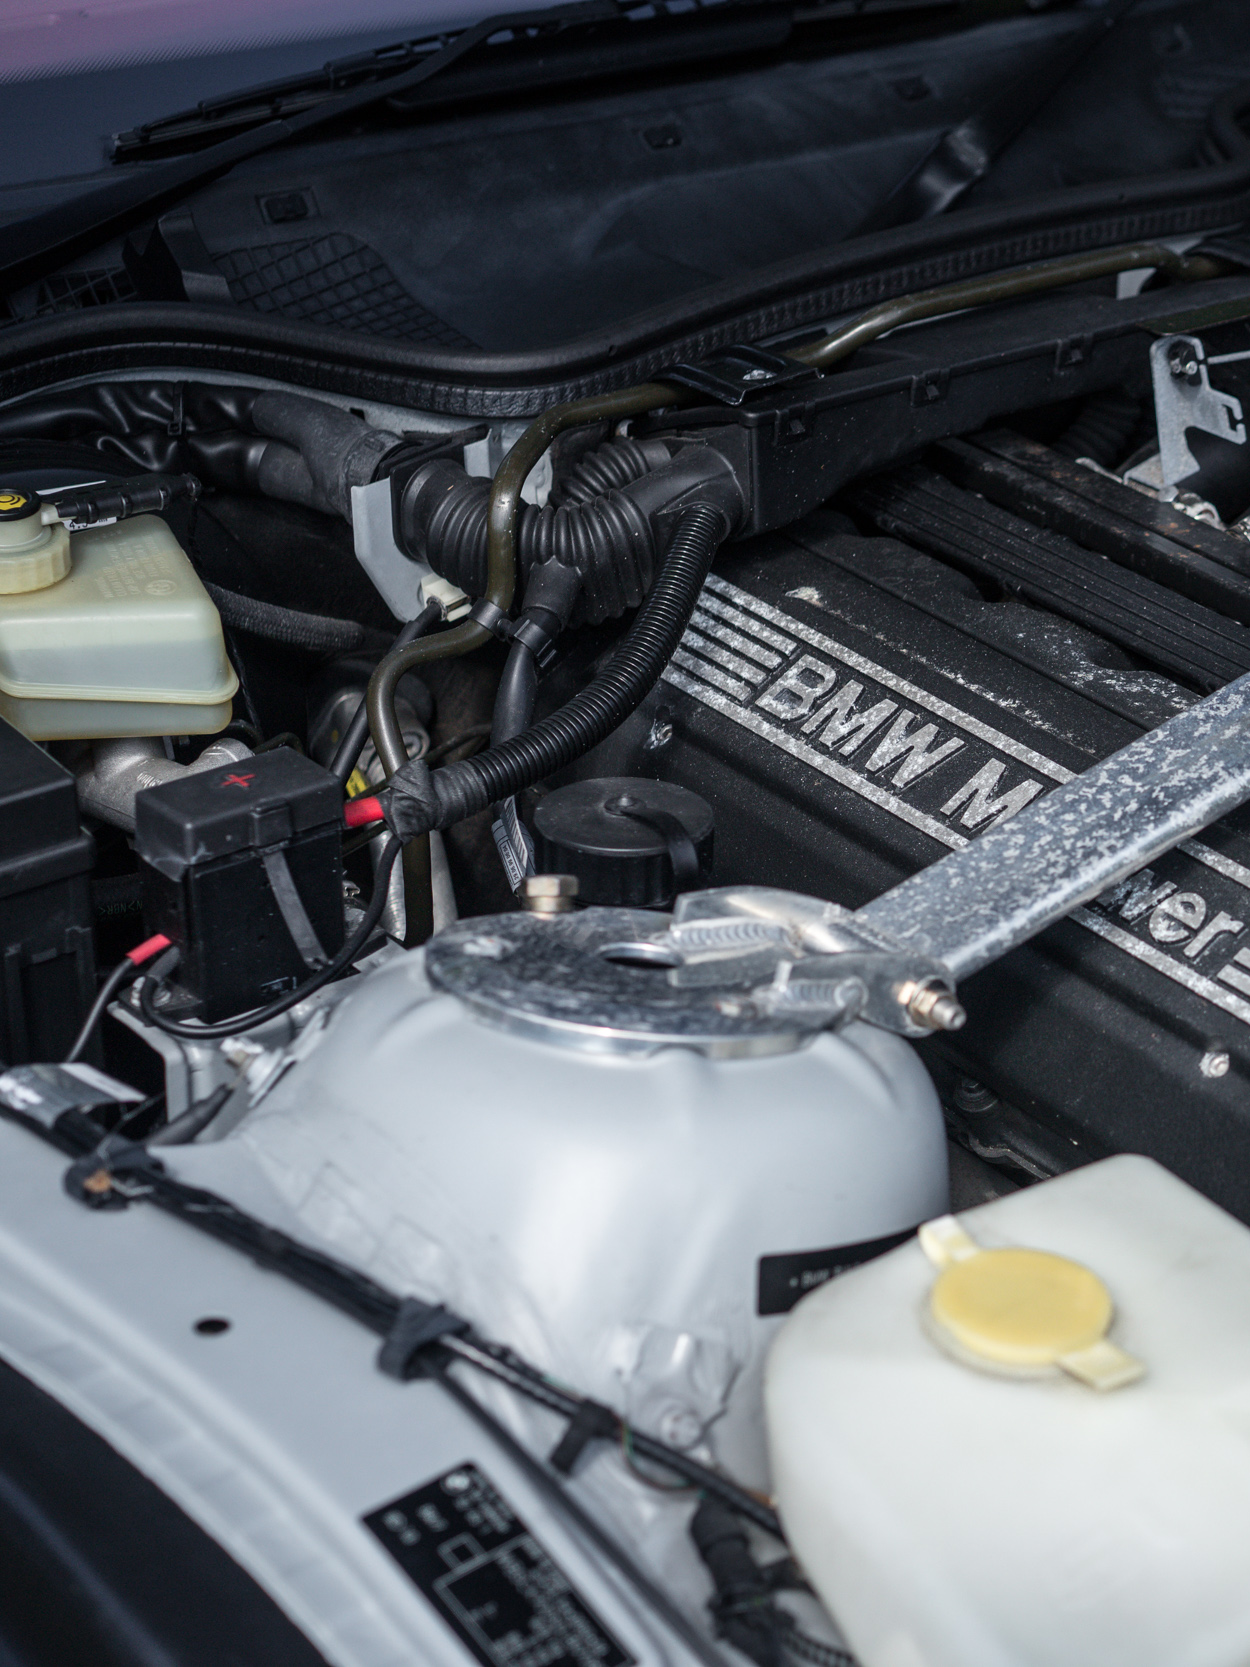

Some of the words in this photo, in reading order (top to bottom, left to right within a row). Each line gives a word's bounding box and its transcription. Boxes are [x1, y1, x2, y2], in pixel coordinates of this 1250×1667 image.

[755, 654, 966, 789] BMW
[940, 758, 1044, 834] M
[1096, 868, 1245, 958] wer
